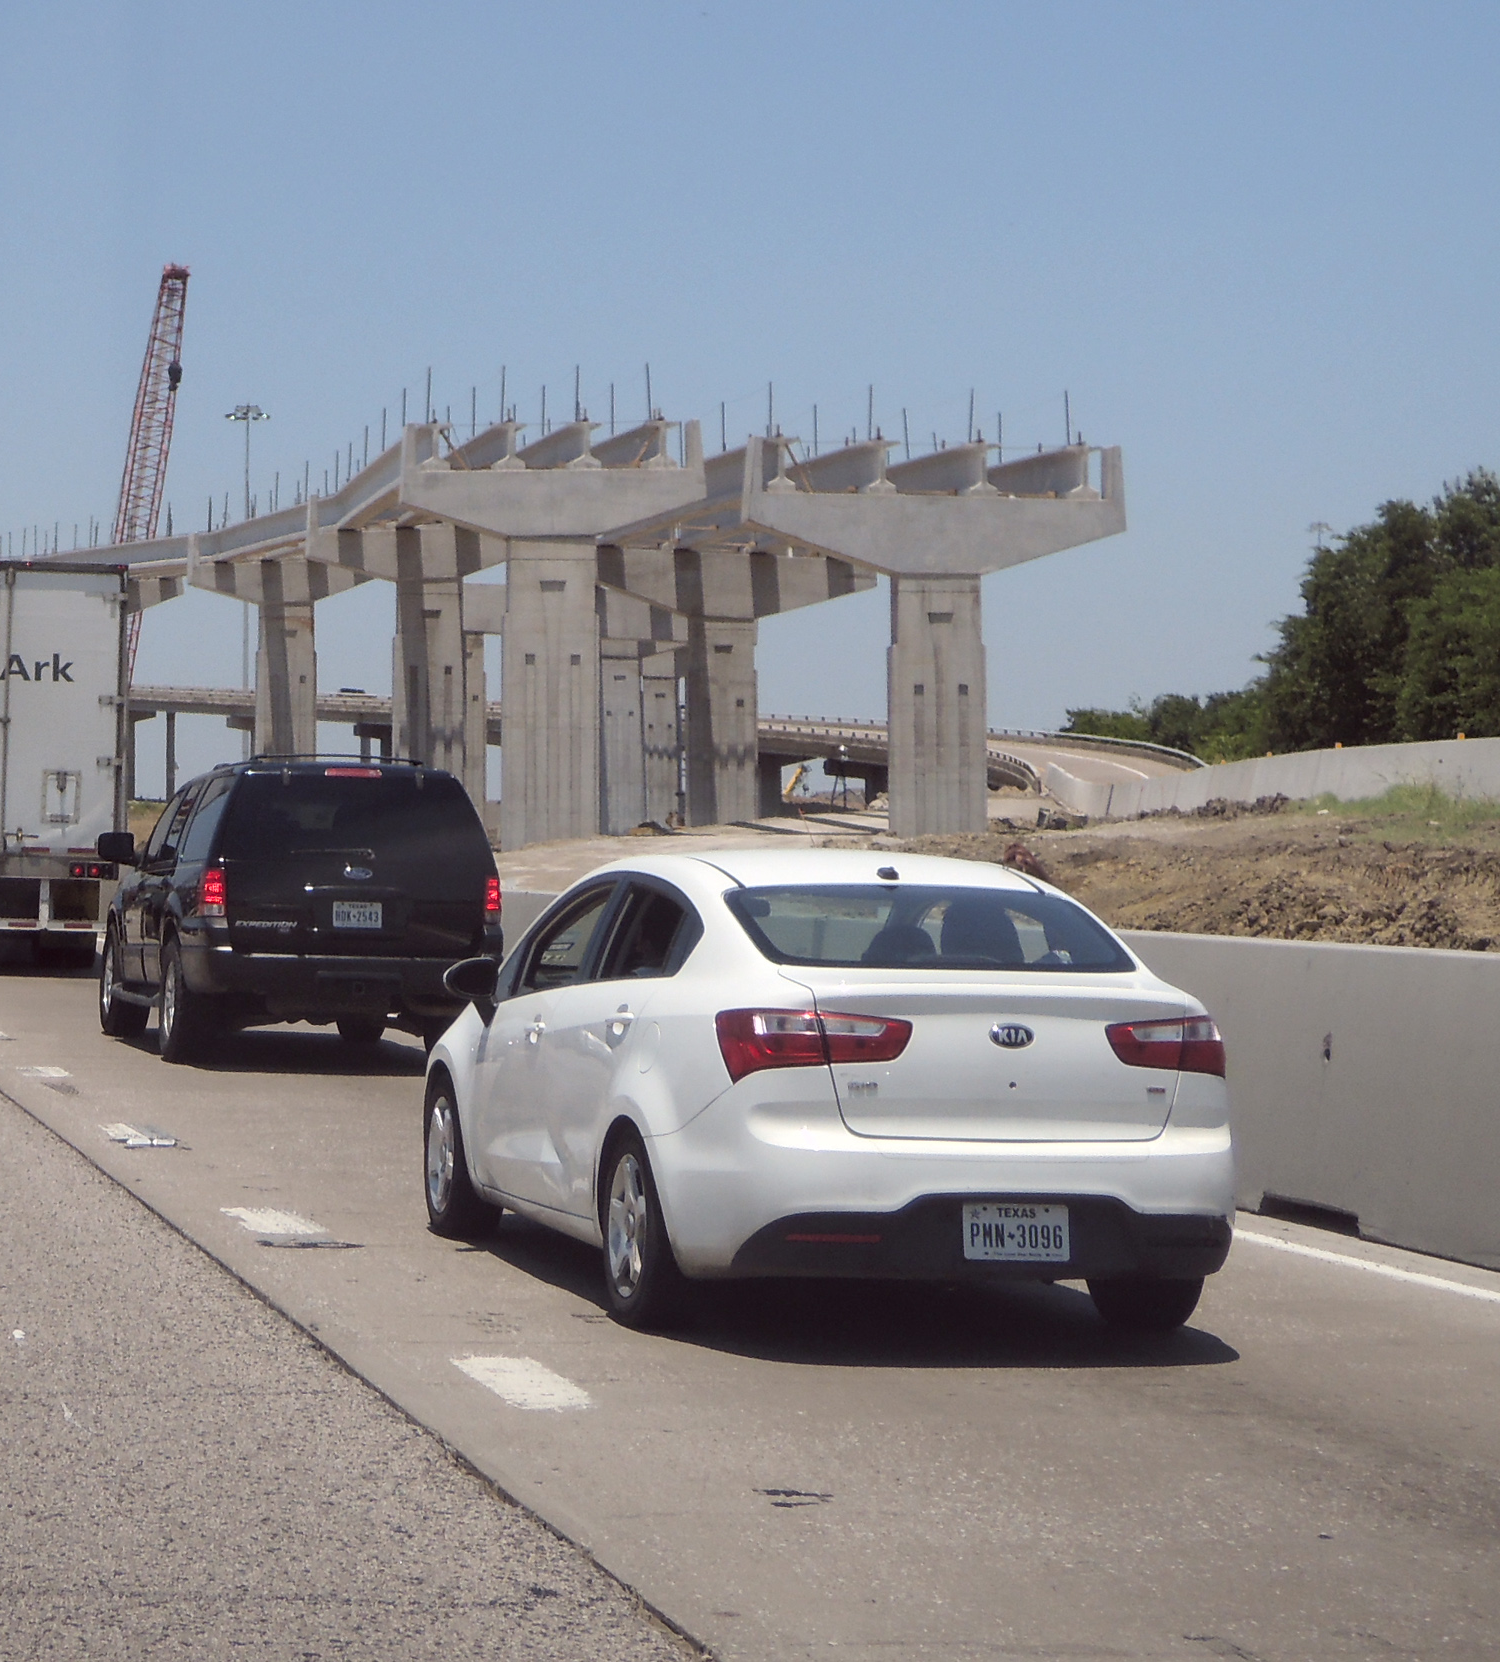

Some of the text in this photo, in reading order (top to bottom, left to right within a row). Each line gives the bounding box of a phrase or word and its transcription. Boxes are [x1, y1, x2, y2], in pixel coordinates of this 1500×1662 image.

[234, 920, 298, 928] EXPEDITION
[998, 1028, 1029, 1043] KIA
[996, 1207, 1037, 1219] TEXAS
